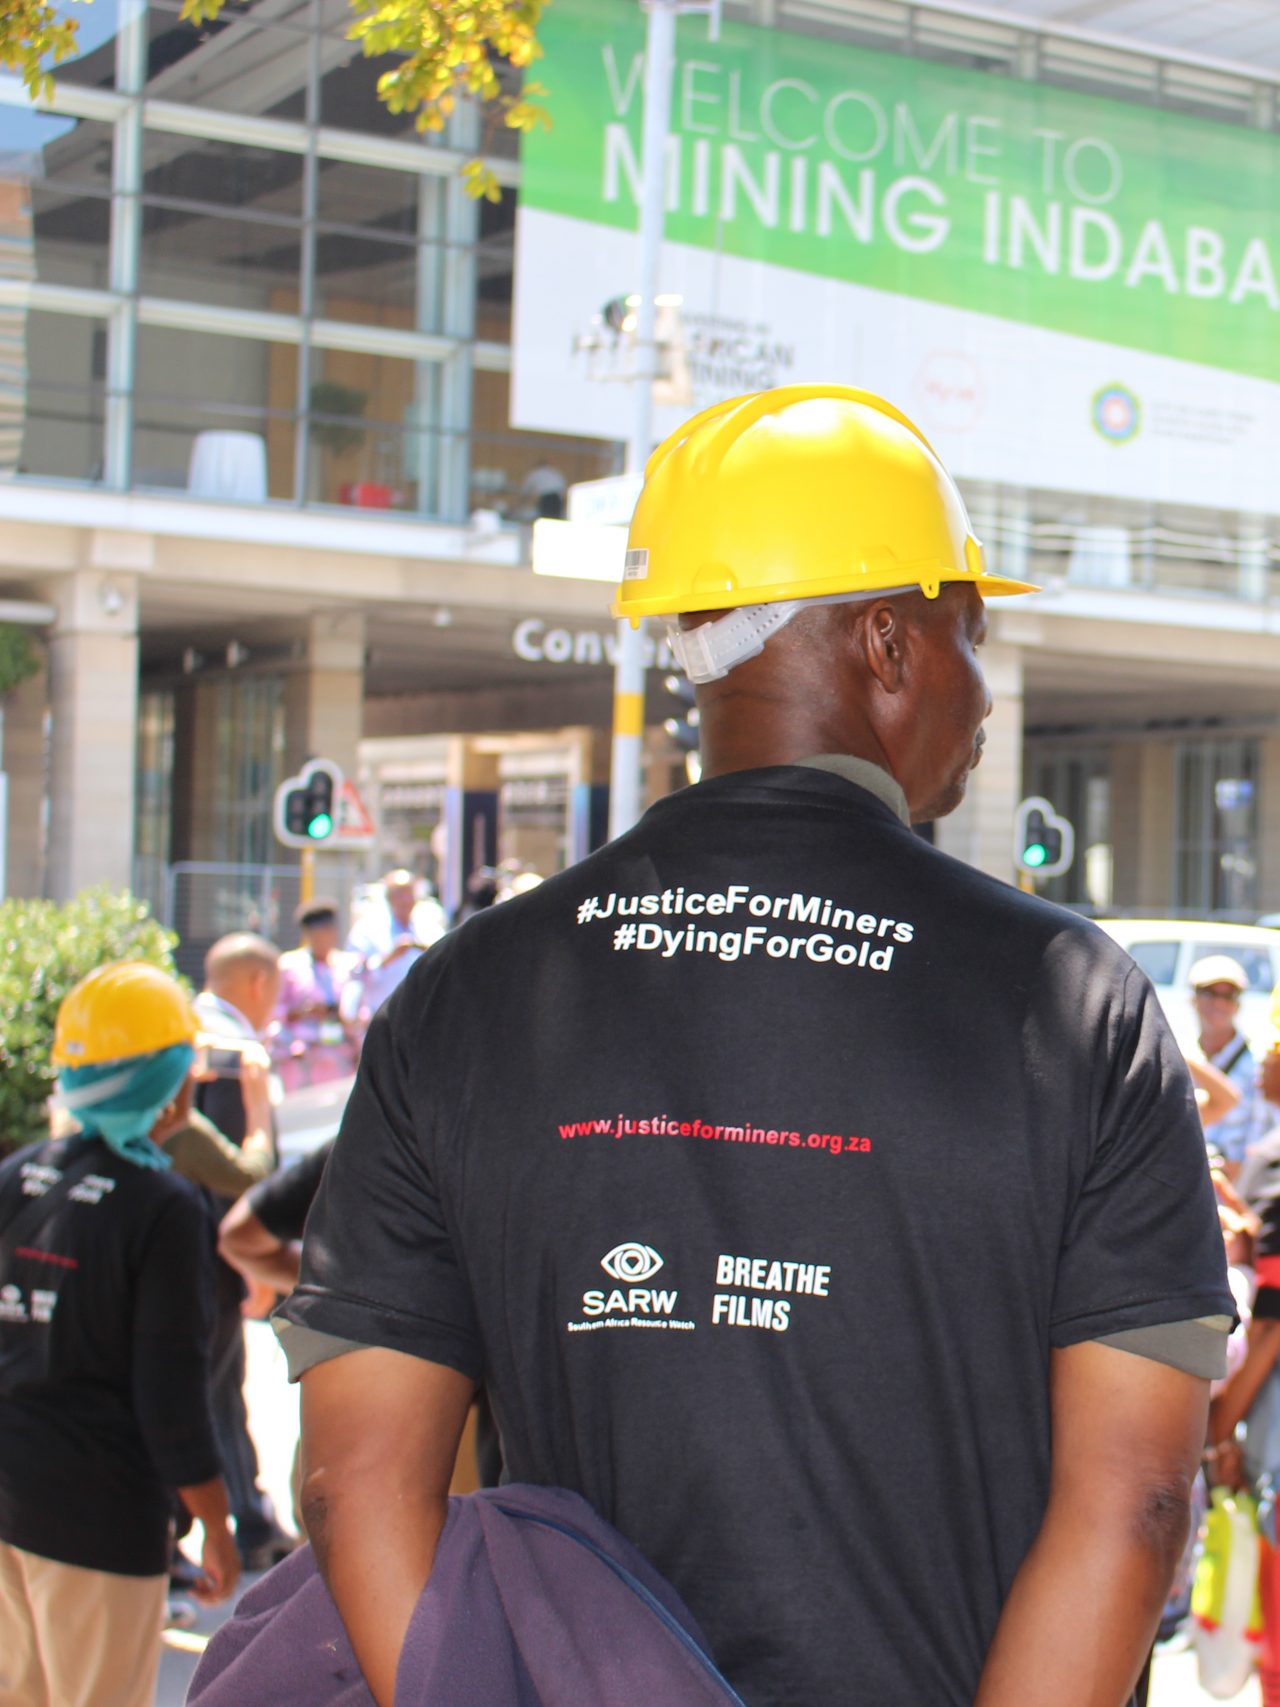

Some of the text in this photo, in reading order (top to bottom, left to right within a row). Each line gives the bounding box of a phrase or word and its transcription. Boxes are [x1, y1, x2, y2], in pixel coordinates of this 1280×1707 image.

[602, 44, 1124, 205] WELCOME TO
[602, 122, 950, 253] MINING
[577, 885, 914, 943] #JusticeForMiners
[613, 923, 893, 971] #DyingForGold
[558, 1113, 872, 1154] www.justiceforminers.org.za
[716, 1254, 831, 1297] BREATHE
[582, 1288, 678, 1316] SARW
[712, 1294, 790, 1332] FILMS
